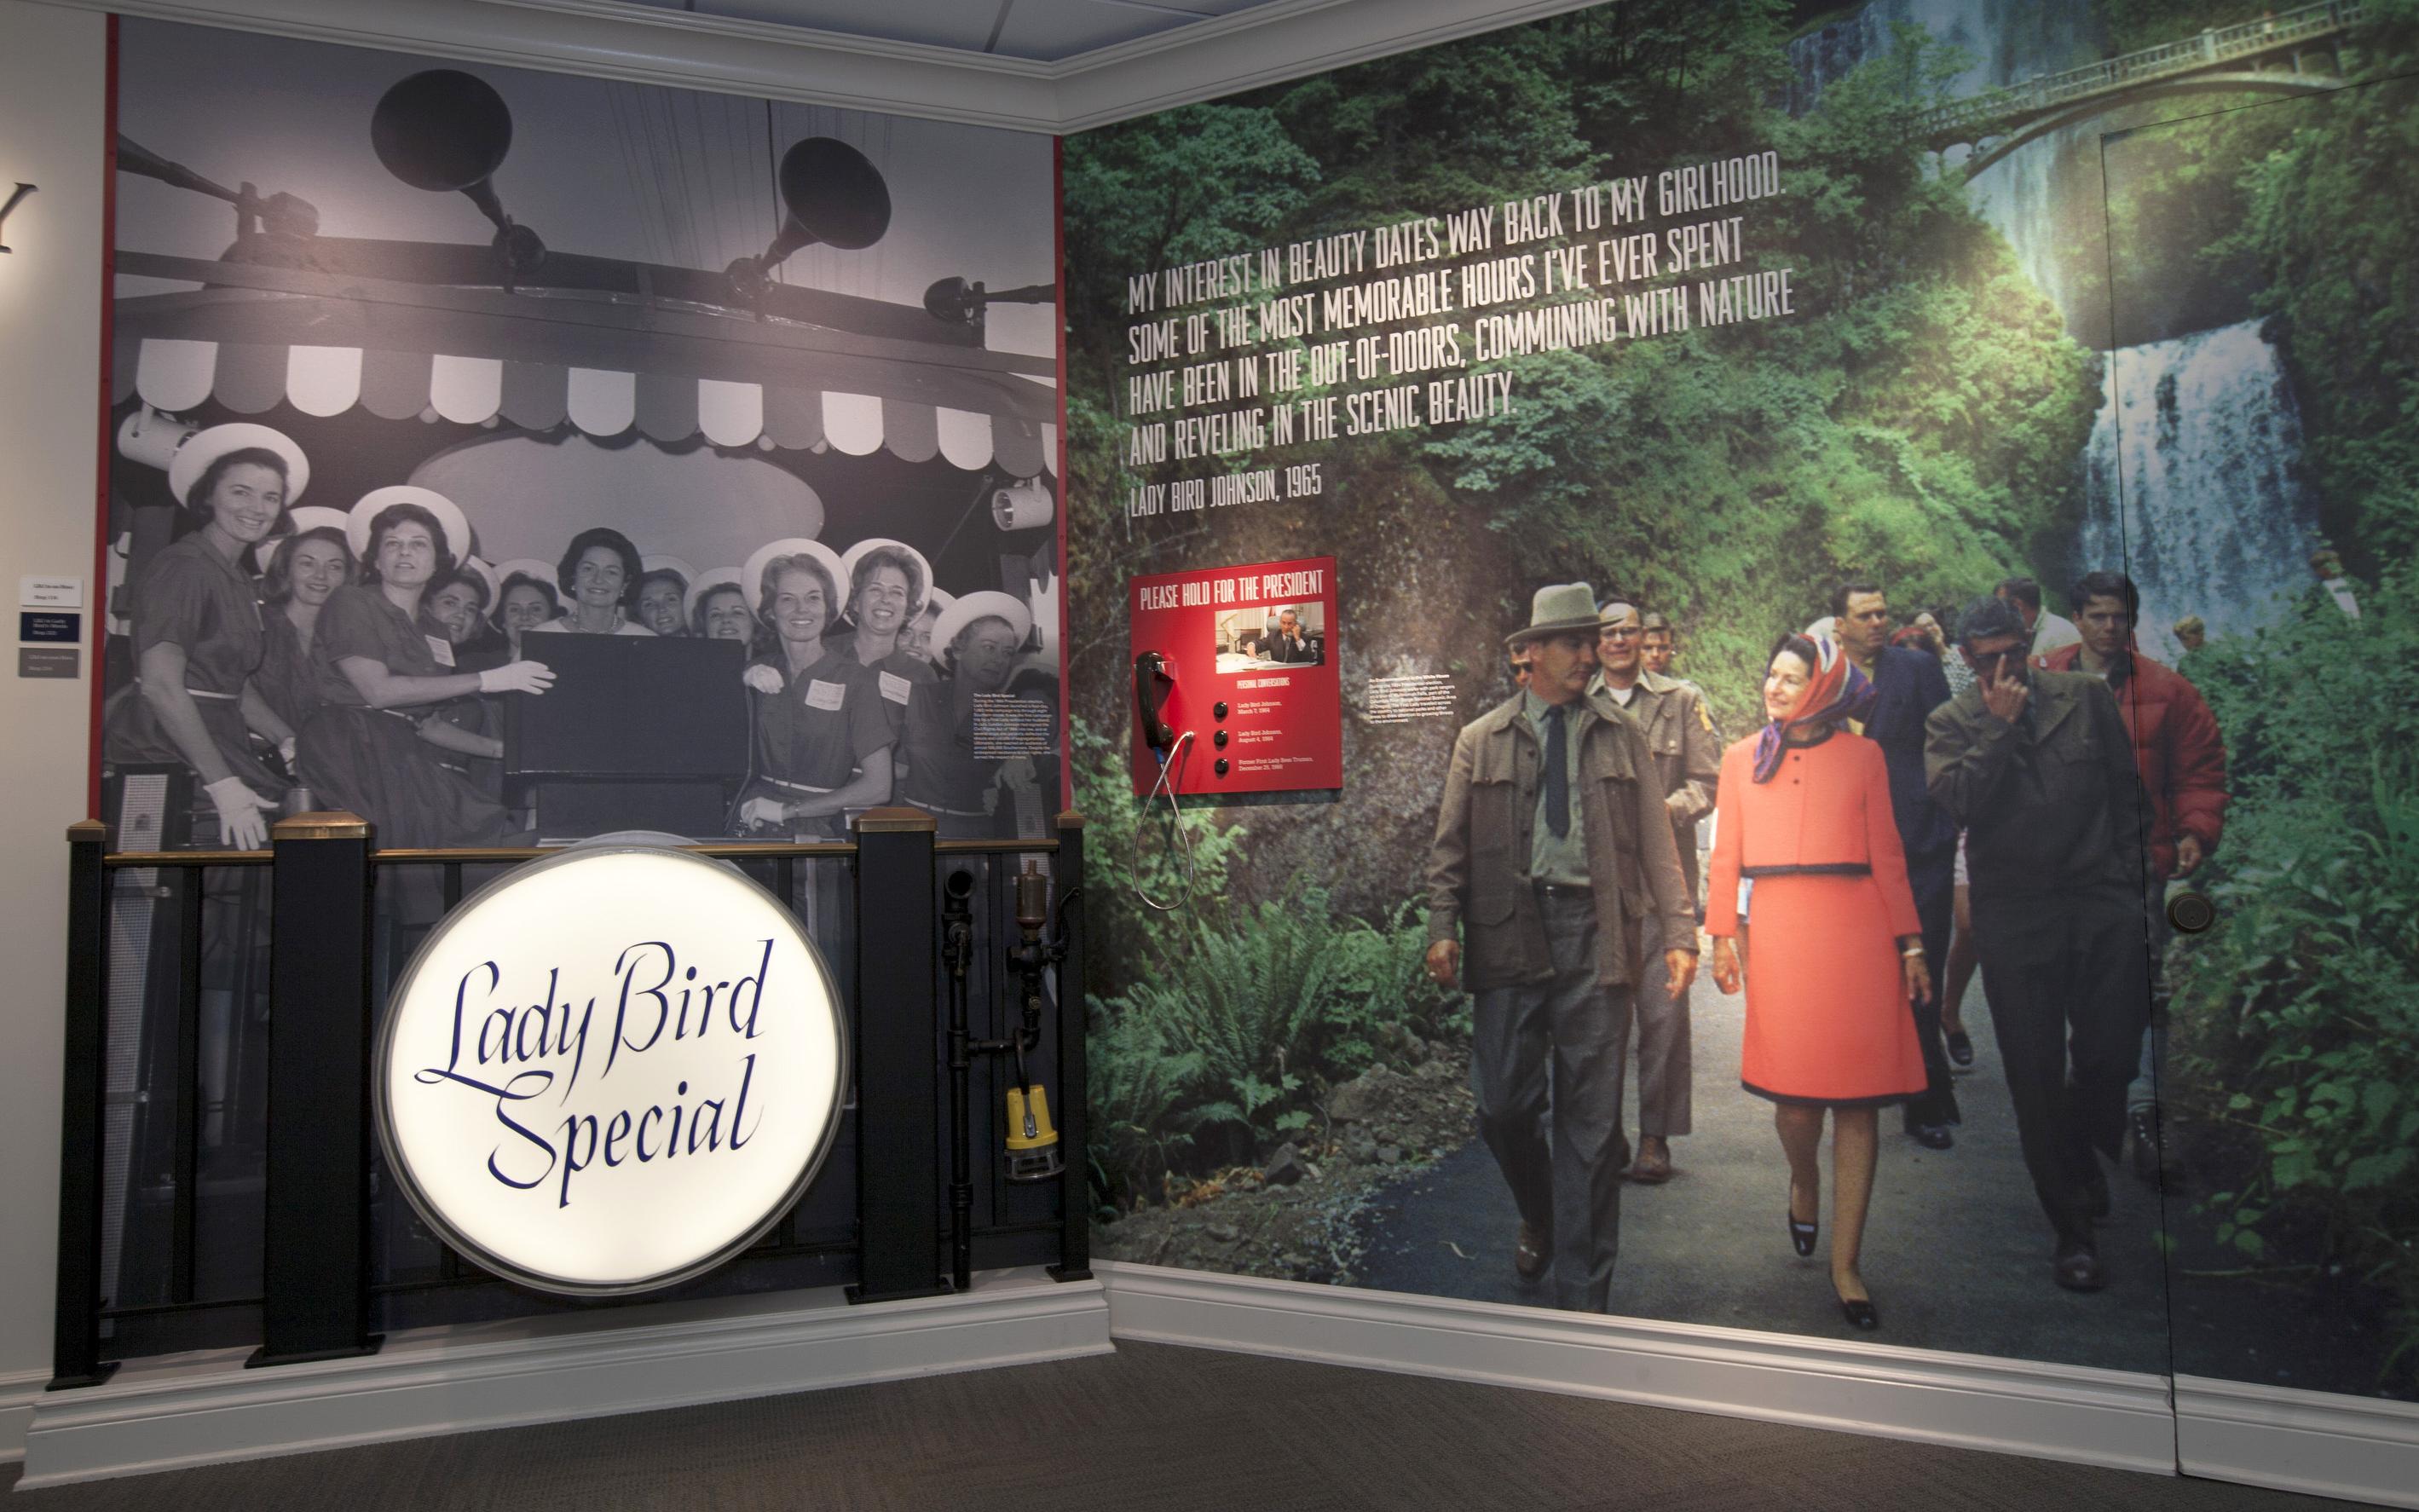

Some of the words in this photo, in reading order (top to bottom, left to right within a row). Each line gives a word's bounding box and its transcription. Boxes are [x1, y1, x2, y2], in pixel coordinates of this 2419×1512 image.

[1129, 272, 1158, 315] MY
[1165, 254, 1252, 308] INTEREST
[1261, 248, 1280, 290] IN
[1289, 230, 1366, 285] BEAUTY
[1375, 216, 1440, 269] DATES
[1446, 205, 1494, 255] WAY
[1504, 192, 1563, 245] BACK
[1571, 186, 1601, 233] TO
[1611, 176, 1648, 226] MY
[1658, 150, 1787, 216] GIRLHOOD.
[1129, 318, 1180, 365] SOME
[1186, 312, 1210, 355] OF
[1216, 304, 1253, 349] THE
[1260, 292, 1315, 343] MOST
[1323, 268, 1453, 332] MEMORABLE
[1461, 254, 1536, 309] HOURS
[1544, 244, 1590, 295] I'VE
[1598, 232, 1659, 286] EVER
[1666, 216, 1743, 274] SPENT
[1129, 369, 1175, 416] HAVE
[1182, 361, 1230, 407] BEEN
[1238, 355, 1259, 399] IN
[1265, 348, 1303, 395] THE
[1310, 323, 1467, 387] OUT-OF-DOORS,
[1475, 297, 1616, 362] COMMUNING
[1625, 285, 1689, 339] WITH
[1700, 268, 1795, 328] NATURE
[1129, 423, 1166, 466] AND
[1175, 407, 1265, 460] REVELING
[1273, 403, 1293, 447] IN
[1300, 396, 1338, 442] THE
[1346, 384, 1421, 436] SCENIC
[1429, 370, 1517, 425] BEAUTY.
[1130, 483, 1166, 517] LADY
[1171, 478, 1205, 512] BIRD
[1210, 469, 1281, 508] JOHNSON,
[1284, 463, 1322, 499] 1965
[1140, 584, 1179, 610] PLEASE
[1182, 581, 1210, 606] HOLD
[1214, 578, 1235, 603] FOR
[1238, 576, 1259, 602] THE
[1262, 569, 1324, 599] PRESIDENT
[414, 961, 596, 1107] Lady
[601, 938, 775, 1080] Bird
[488, 1053, 765, 1209] Special
